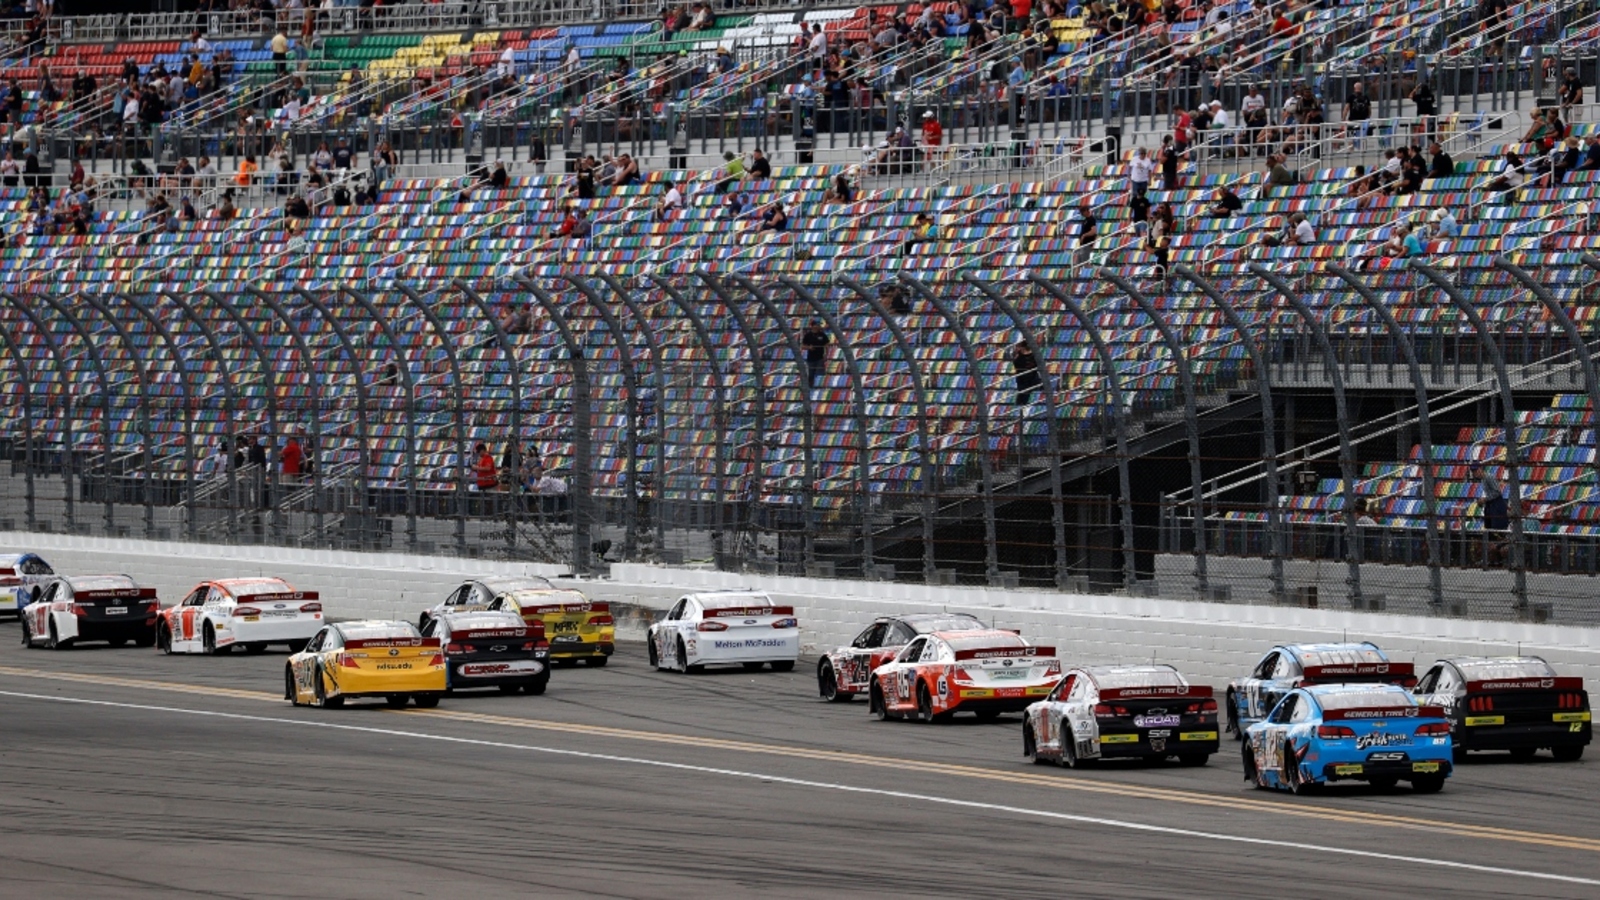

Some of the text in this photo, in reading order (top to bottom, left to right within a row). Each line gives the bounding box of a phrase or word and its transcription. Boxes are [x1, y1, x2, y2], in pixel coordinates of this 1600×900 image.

[1119, 687, 1176, 696] GENERAL TIRE
[1343, 709, 1404, 718] GENERAL TIRE
[1568, 722, 1583, 733] 12
[1369, 752, 1405, 761] SS
